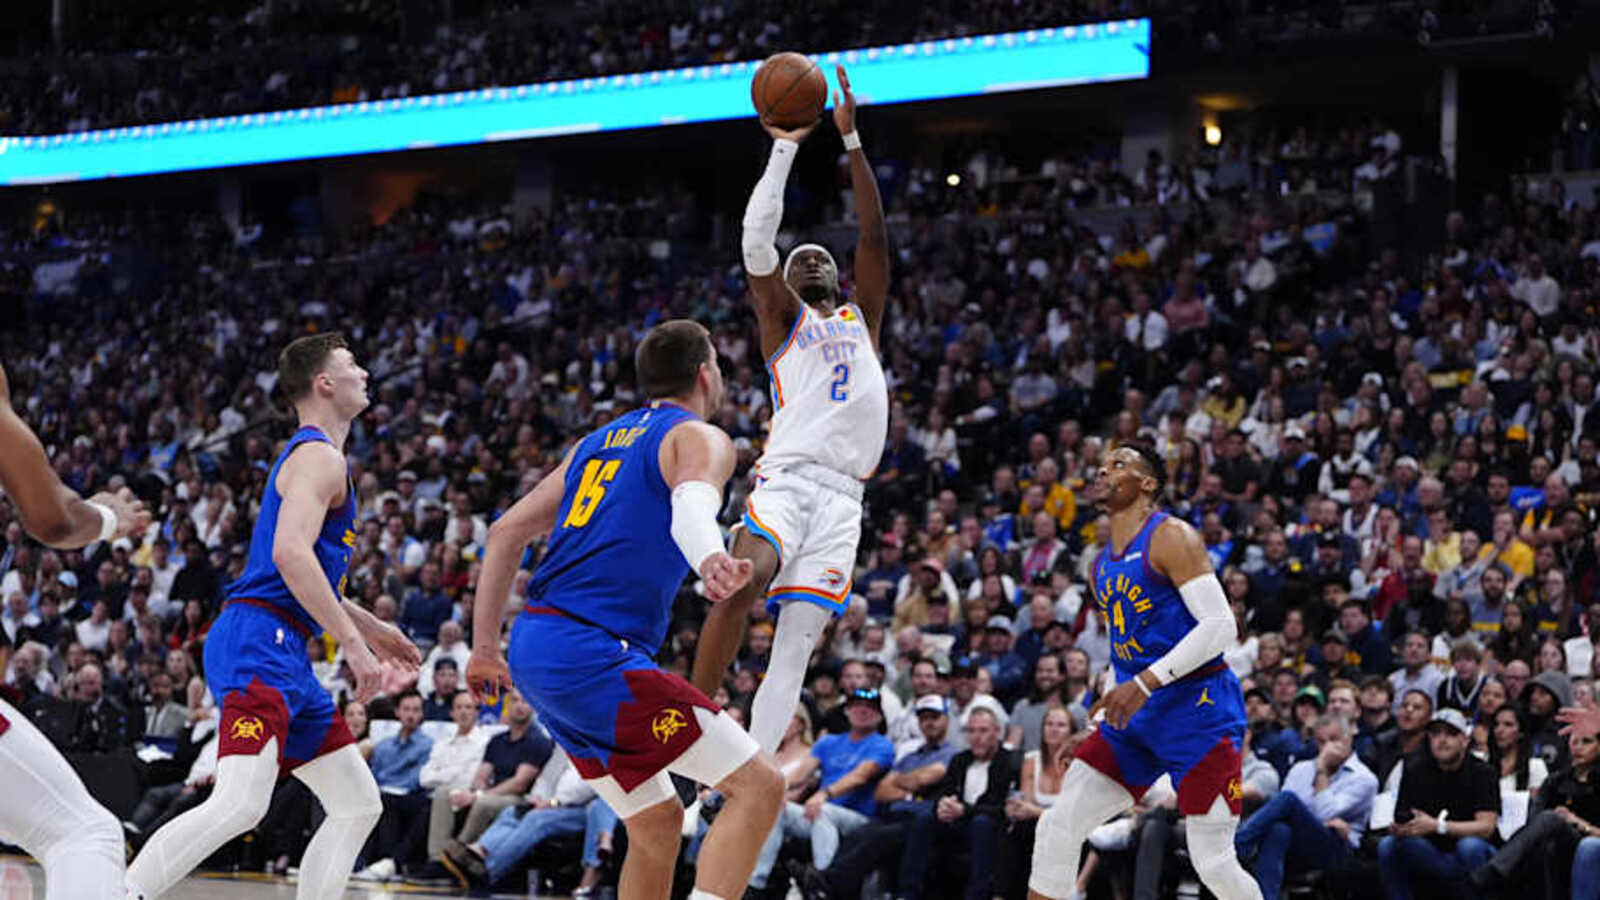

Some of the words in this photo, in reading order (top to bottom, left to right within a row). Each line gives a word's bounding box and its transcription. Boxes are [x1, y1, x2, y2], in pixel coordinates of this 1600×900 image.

[822, 340, 857, 363] CITY
[829, 363, 851, 403] 2
[563, 458, 622, 528] 15
[1116, 573, 1153, 613] HIGH
[1113, 600, 1125, 635] 4
[1113, 636, 1144, 660] CITY
